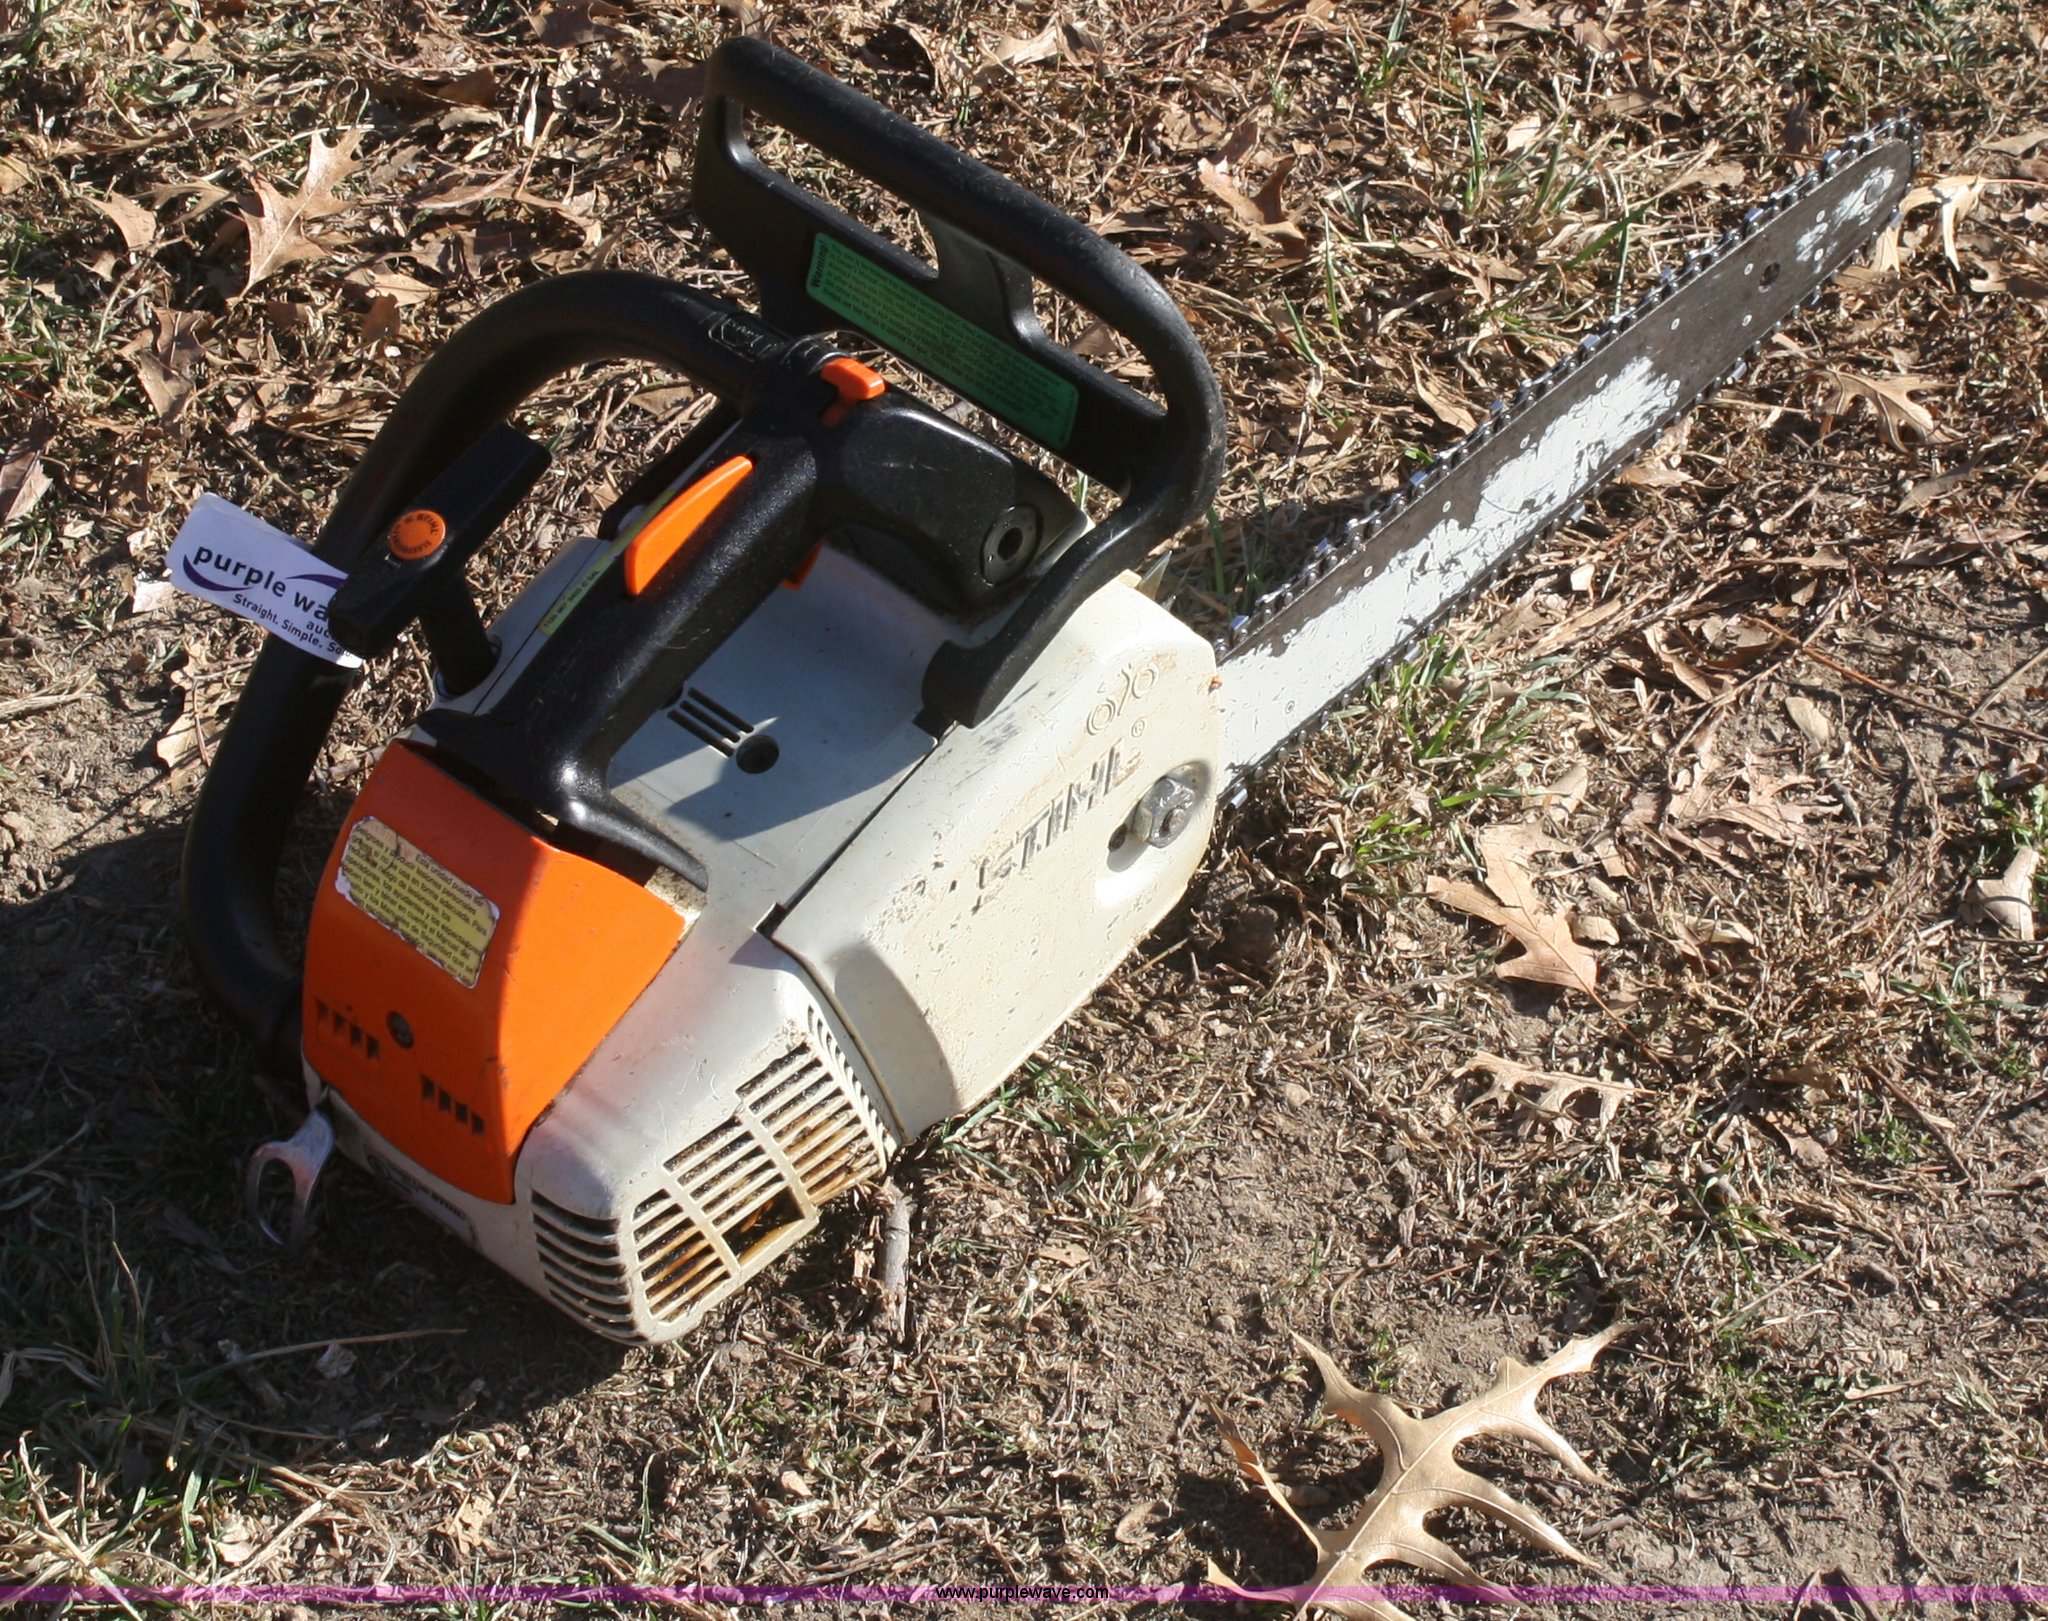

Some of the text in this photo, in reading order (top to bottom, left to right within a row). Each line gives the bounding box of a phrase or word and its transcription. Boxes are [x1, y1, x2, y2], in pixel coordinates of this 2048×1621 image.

[193, 546, 329, 622] purple wa
[233, 593, 279, 625] Straight.
[281, 619, 322, 648] Simple.
[972, 740, 1142, 915] STIHL
